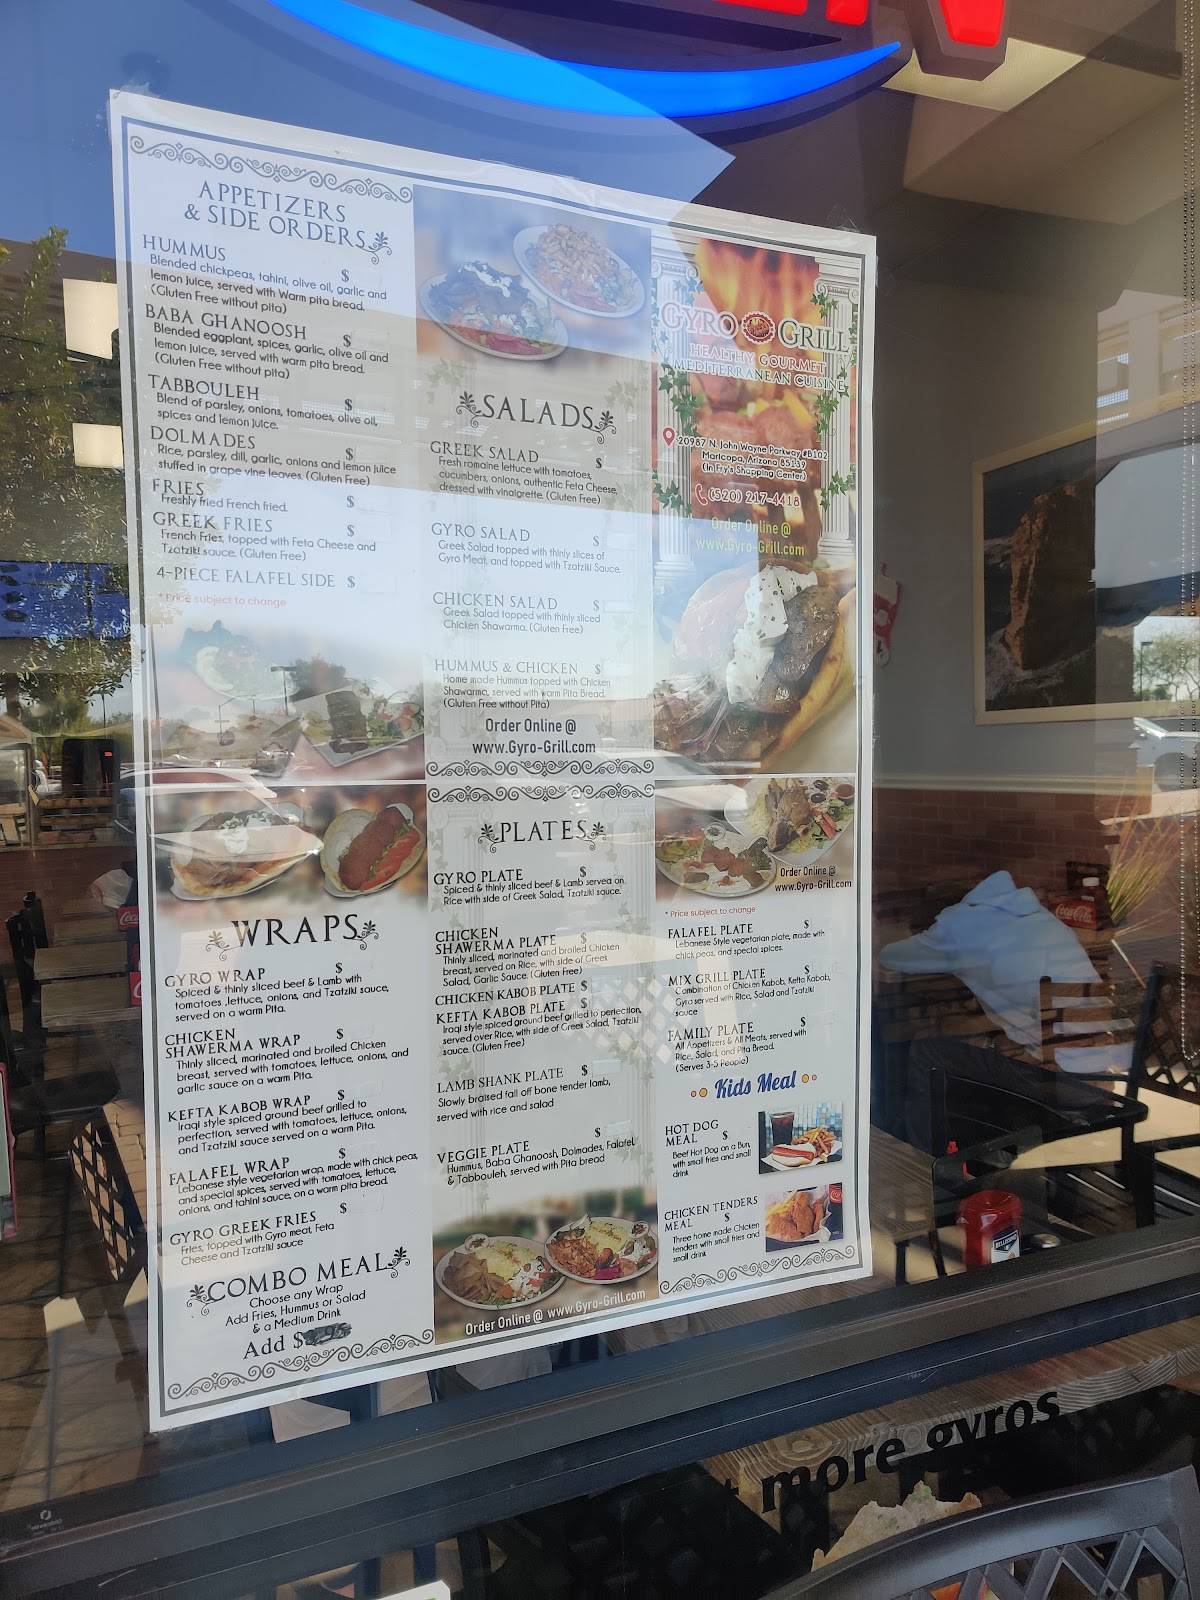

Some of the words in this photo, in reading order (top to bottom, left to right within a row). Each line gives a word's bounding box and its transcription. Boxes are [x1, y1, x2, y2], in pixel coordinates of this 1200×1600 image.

[197, 180, 345, 223] APPETIZERS
[183, 203, 200, 221] &
[207, 204, 260, 231] SIDE
[268, 215, 366, 251] ORDERS
[142, 233, 226, 262] HUMMUS
[149, 253, 197, 271] Blended
[291, 276, 316, 290] olive
[336, 285, 365, 297] garlic
[367, 290, 387, 300] and
[340, 268, 350, 283] $
[150, 283, 192, 300] (Gluten
[194, 289, 218, 304] Free
[221, 296, 258, 310] without
[260, 302, 287, 315] pita)
[145, 303, 194, 325] BABA
[200, 312, 307, 340] GHANOOSH
[661, 303, 736, 337] GYRO
[779, 319, 850, 353] GRILL
[689, 343, 755, 362] HEALTHY
[760, 354, 826, 374] GOURMET
[147, 373, 260, 401] TABBOULEH
[673, 359, 791, 385] MEDITERRANEAN
[794, 374, 846, 392] CUISINE
[483, 394, 594, 431] SALADS
[150, 424, 255, 450] DOLMADES
[429, 440, 484, 460] GREEK
[487, 445, 539, 463] SALAD
[720, 441, 738, 450] John
[740, 443, 767, 454] Wayne
[769, 446, 801, 457] Parkway
[802, 450, 828, 460] #B102
[748, 456, 778, 466] Arizona
[780, 458, 806, 469] 85139
[736, 466, 773, 478] Shopping
[776, 469, 807, 481] Center)
[152, 477, 205, 497] FRIES
[708, 488, 742, 503] (520)
[746, 490, 800, 507] 217-4418
[346, 494, 355, 508] $
[152, 511, 219, 530] GREEK
[223, 515, 273, 533] FRIES
[430, 522, 475, 538] GYRO
[480, 526, 530, 542] SALAD
[156, 565, 220, 582] 4-PIECE
[225, 569, 298, 586] FALAFEL
[299, 572, 335, 588] SIDE
[347, 575, 355, 589] $
[432, 591, 504, 610] CHICKEN
[506, 595, 558, 610] SALAD
[433, 658, 498, 674] HUMMUS
[502, 662, 513, 673] &
[514, 661, 578, 675] CHICKEN
[485, 717, 522, 732] Order
[523, 717, 562, 732] Online
[565, 718, 576, 735] @
[471, 739, 596, 757] www.Gyro-Grill.com
[499, 819, 587, 843] PLATES
[433, 870, 476, 886] GYRO
[480, 868, 523, 883] PLATE
[579, 865, 586, 878] $
[779, 866, 802, 877] Order
[802, 864, 827, 876] Online
[828, 865, 836, 876] @
[774, 879, 852, 892] www.Gyro-Grill.com
[230, 913, 359, 947] WRAPS
[435, 926, 498, 943] CHICKEN
[667, 925, 717, 939] FALAFEL
[720, 923, 753, 935] PLATE
[435, 938, 515, 955] SHAWERMA
[519, 933, 556, 948] PLATE
[164, 971, 212, 988] GYRO
[217, 967, 265, 983] WRAP
[667, 973, 692, 987] MIX
[695, 971, 729, 984] GRILL
[732, 967, 765, 981] PLATE
[434, 990, 494, 1006] CHICKEN
[496, 985, 537, 1000] KABOB
[539, 982, 575, 996] PLATE
[436, 1009, 478, 1025] KEFTA
[482, 1004, 526, 1020] KABOB
[529, 1000, 565, 1014] PLATE
[164, 1027, 235, 1046] CHICKEN
[667, 1026, 713, 1042] FAMILY
[716, 1021, 754, 1036] PLATE
[165, 1039, 253, 1059] SHAWERMA
[258, 1033, 300, 1049] WRAP
[176, 1057, 203, 1070] Thinly
[241, 1048, 290, 1063] marinated
[292, 1046, 311, 1058] and
[313, 1042, 347, 1055] broiled
[349, 1040, 386, 1051] Chicken
[436, 1078, 475, 1094] LAMB
[478, 1072, 522, 1088] SHANK
[524, 1067, 563, 1082] PLATE
[581, 1064, 588, 1076] $
[714, 1077, 751, 1099] Kids
[756, 1069, 796, 1093] Meal
[167, 1106, 214, 1122] KEFTA
[218, 1099, 267, 1115] KABOB
[271, 1094, 310, 1109] WRAP
[665, 1122, 689, 1136] HOT
[692, 1119, 719, 1132] DOG
[436, 1146, 488, 1164] VEGGIE
[490, 1140, 530, 1157] PLATE
[665, 1133, 698, 1147] MEAL
[169, 1163, 239, 1186] FALAFEL
[243, 1156, 289, 1174] WRAP
[447, 1175, 455, 1186] &
[509, 1162, 540, 1176] served
[541, 1160, 559, 1171] with
[560, 1158, 577, 1168] Pita
[578, 1152, 605, 1166] bread
[664, 1203, 709, 1221] CHICKEN
[712, 1195, 758, 1212] TENDERS
[169, 1227, 214, 1246] GYRO
[218, 1218, 271, 1237] GREEK
[275, 1210, 316, 1228] FRIES
[664, 1218, 693, 1232] MEAL
[207, 1266, 307, 1303] COMBO
[316, 1252, 389, 1282] MEAL
[225, 1312, 249, 1327] Add
[280, 1301, 319, 1316] Hummus
[321, 1298, 332, 1307] or
[335, 1289, 366, 1304] Salad
[249, 1294, 291, 1309] Choose
[293, 1289, 313, 1300] any
[314, 1283, 343, 1296] Wrap
[252, 1322, 260, 1334] &
[263, 1323, 271, 1331] a
[274, 1315, 314, 1330] Medium
[316, 1307, 341, 1321] Drink
[465, 1319, 496, 1335] Order
[497, 1311, 531, 1328] Online
[532, 1308, 543, 1324] @
[545, 1288, 645, 1319] www.Gyro-Grill.com
[242, 1334, 285, 1359] Add
[292, 1330, 304, 1349] $
[761, 1438, 905, 1513] more
